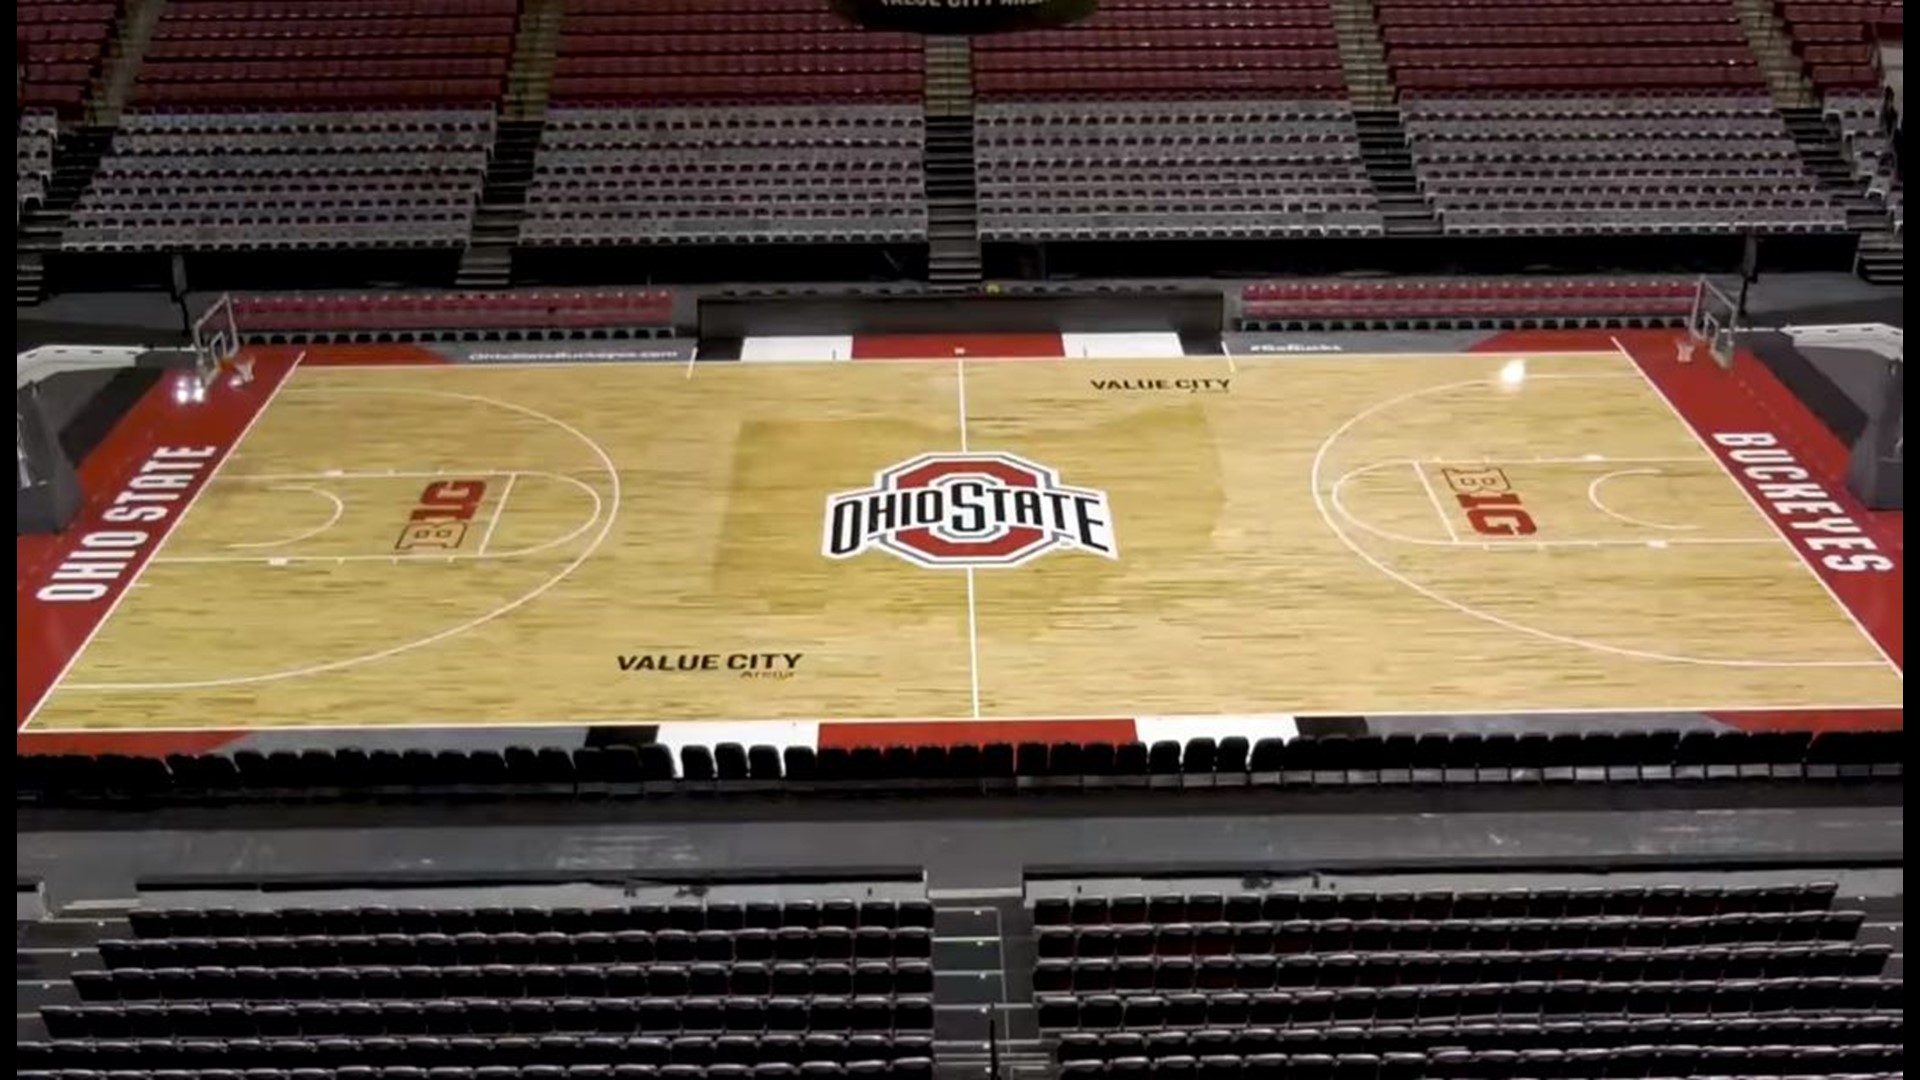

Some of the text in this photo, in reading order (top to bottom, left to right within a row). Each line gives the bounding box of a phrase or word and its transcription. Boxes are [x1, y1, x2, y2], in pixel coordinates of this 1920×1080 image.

[1090, 379, 1229, 390] VALUE CITY
[35, 446, 217, 601] OHIO STATE
[830, 482, 1110, 555] OHIO STATE
[1711, 432, 1894, 572] BUCKEYES
[617, 654, 803, 671] VALUE CITY
